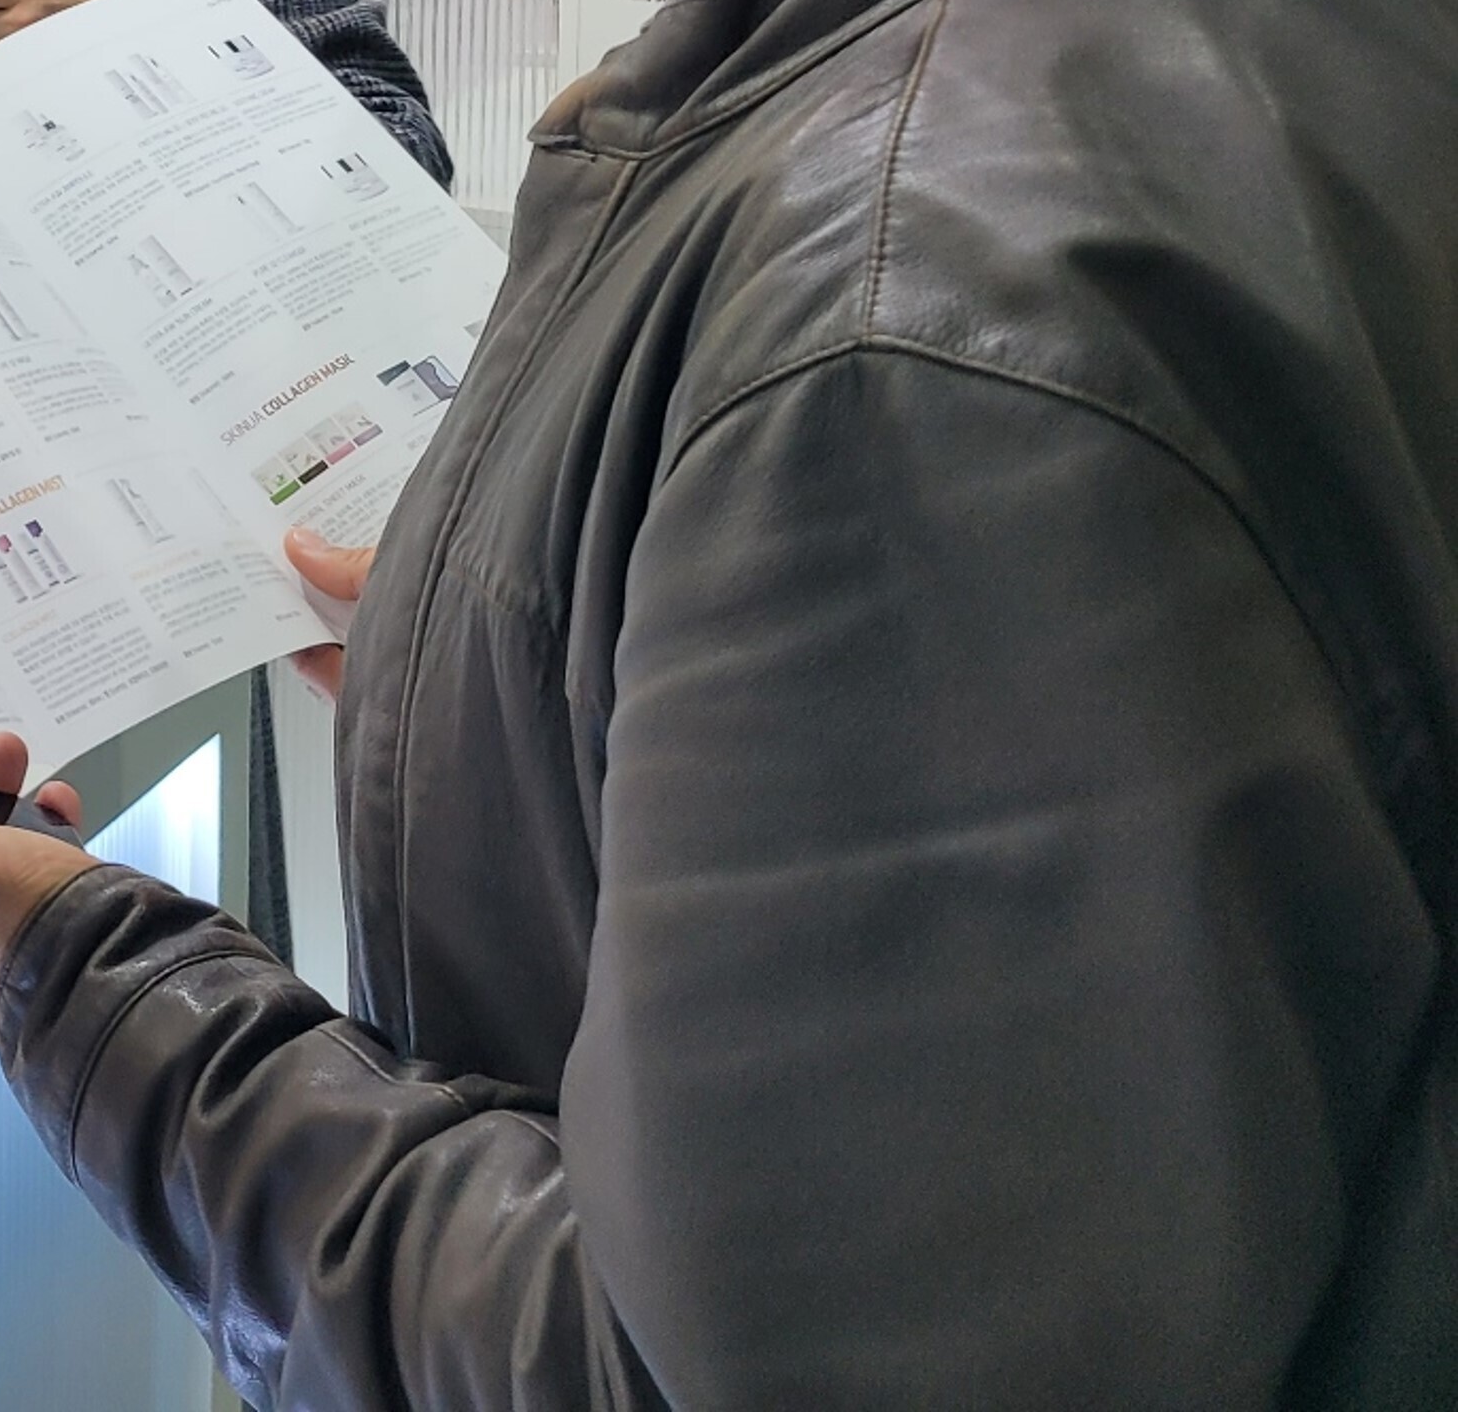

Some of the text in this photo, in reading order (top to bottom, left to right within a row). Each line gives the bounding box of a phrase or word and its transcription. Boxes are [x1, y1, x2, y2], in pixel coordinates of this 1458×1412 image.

[262, 371, 322, 417] COLLAGEN
[322, 353, 355, 378] MASK
[39, 474, 67, 497] MIST
